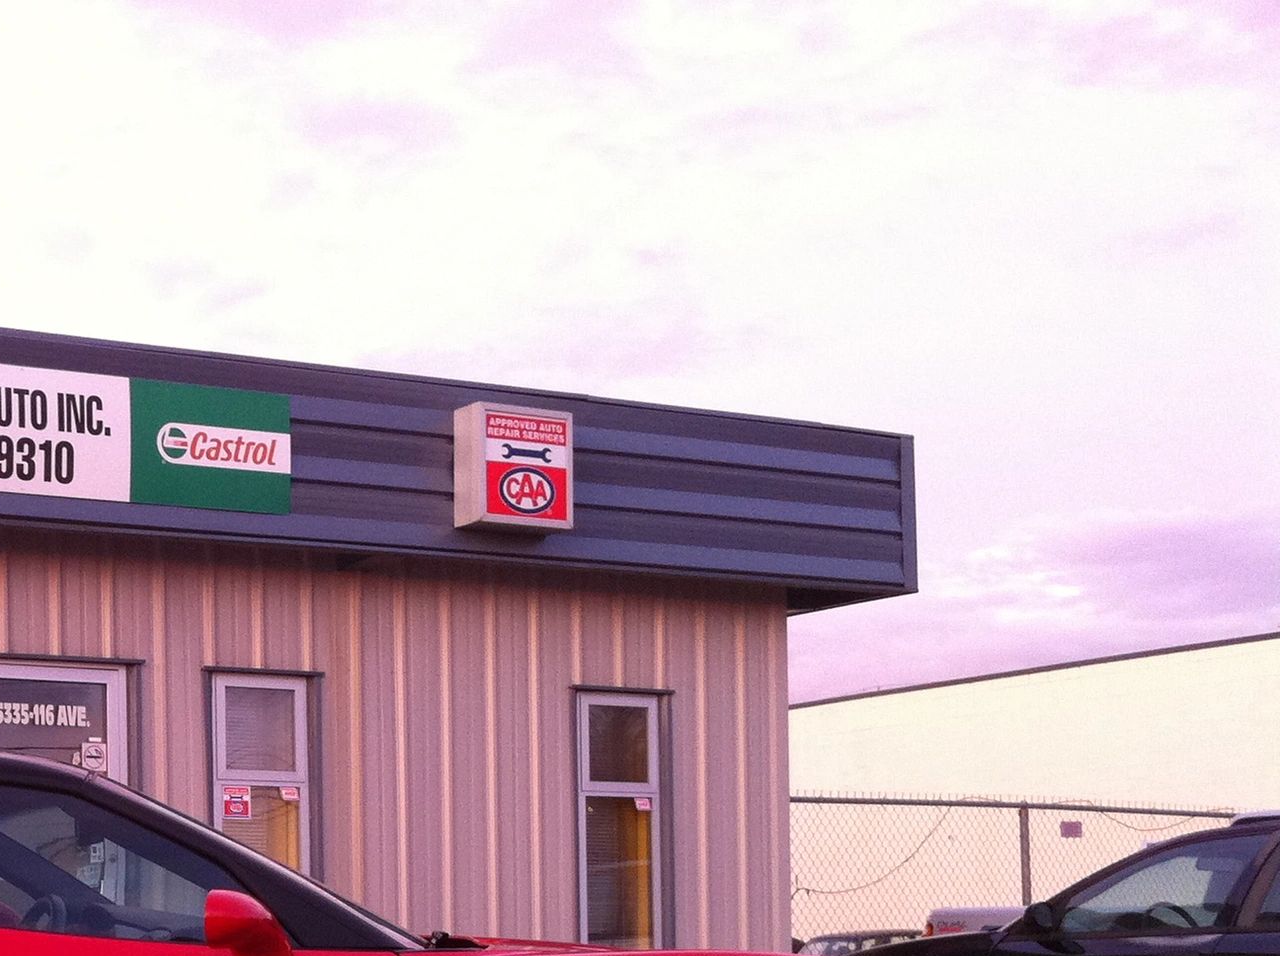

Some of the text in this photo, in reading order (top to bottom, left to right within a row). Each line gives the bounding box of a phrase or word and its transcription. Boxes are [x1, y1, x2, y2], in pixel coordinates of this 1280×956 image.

[57, 392, 111, 436] INC.
[489, 417, 563, 434] APPROVED AUTO
[190, 431, 277, 466] Castrol
[487, 427, 565, 444] REPAIR SERVICES
[506, 473, 548, 507] CAA
[57, 704, 91, 728] AVE.
